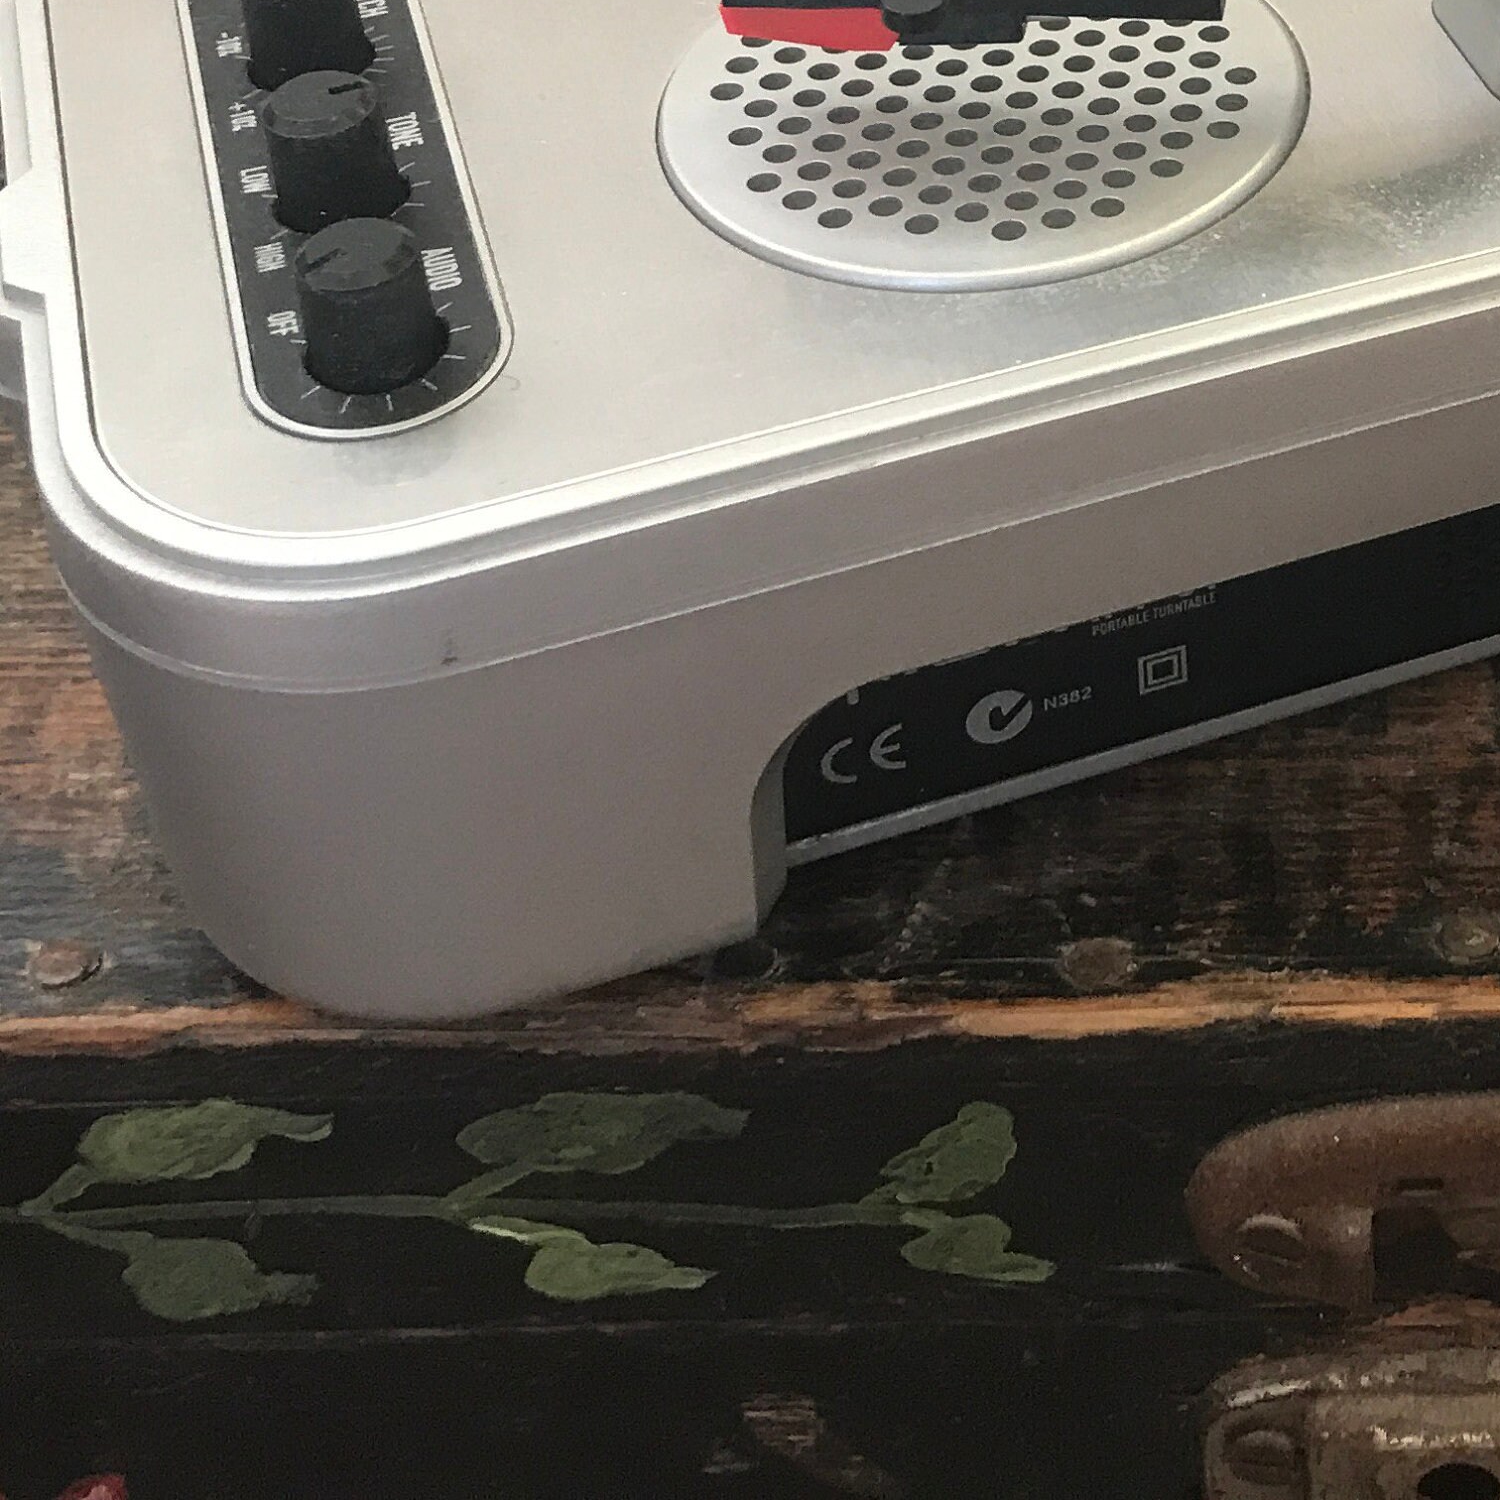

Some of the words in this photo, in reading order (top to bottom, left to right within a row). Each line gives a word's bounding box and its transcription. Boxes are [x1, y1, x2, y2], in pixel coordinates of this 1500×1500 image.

[385, 112, 424, 151] TONE
[239, 165, 272, 193] LOW
[254, 241, 287, 273] HIGH
[420, 247, 463, 291] AUDIO
[267, 310, 299, 336] OFF
[1092, 610, 1150, 637] PORTABLE
[1152, 591, 1217, 620] TURNTABLE
[1043, 685, 1093, 712] N382
